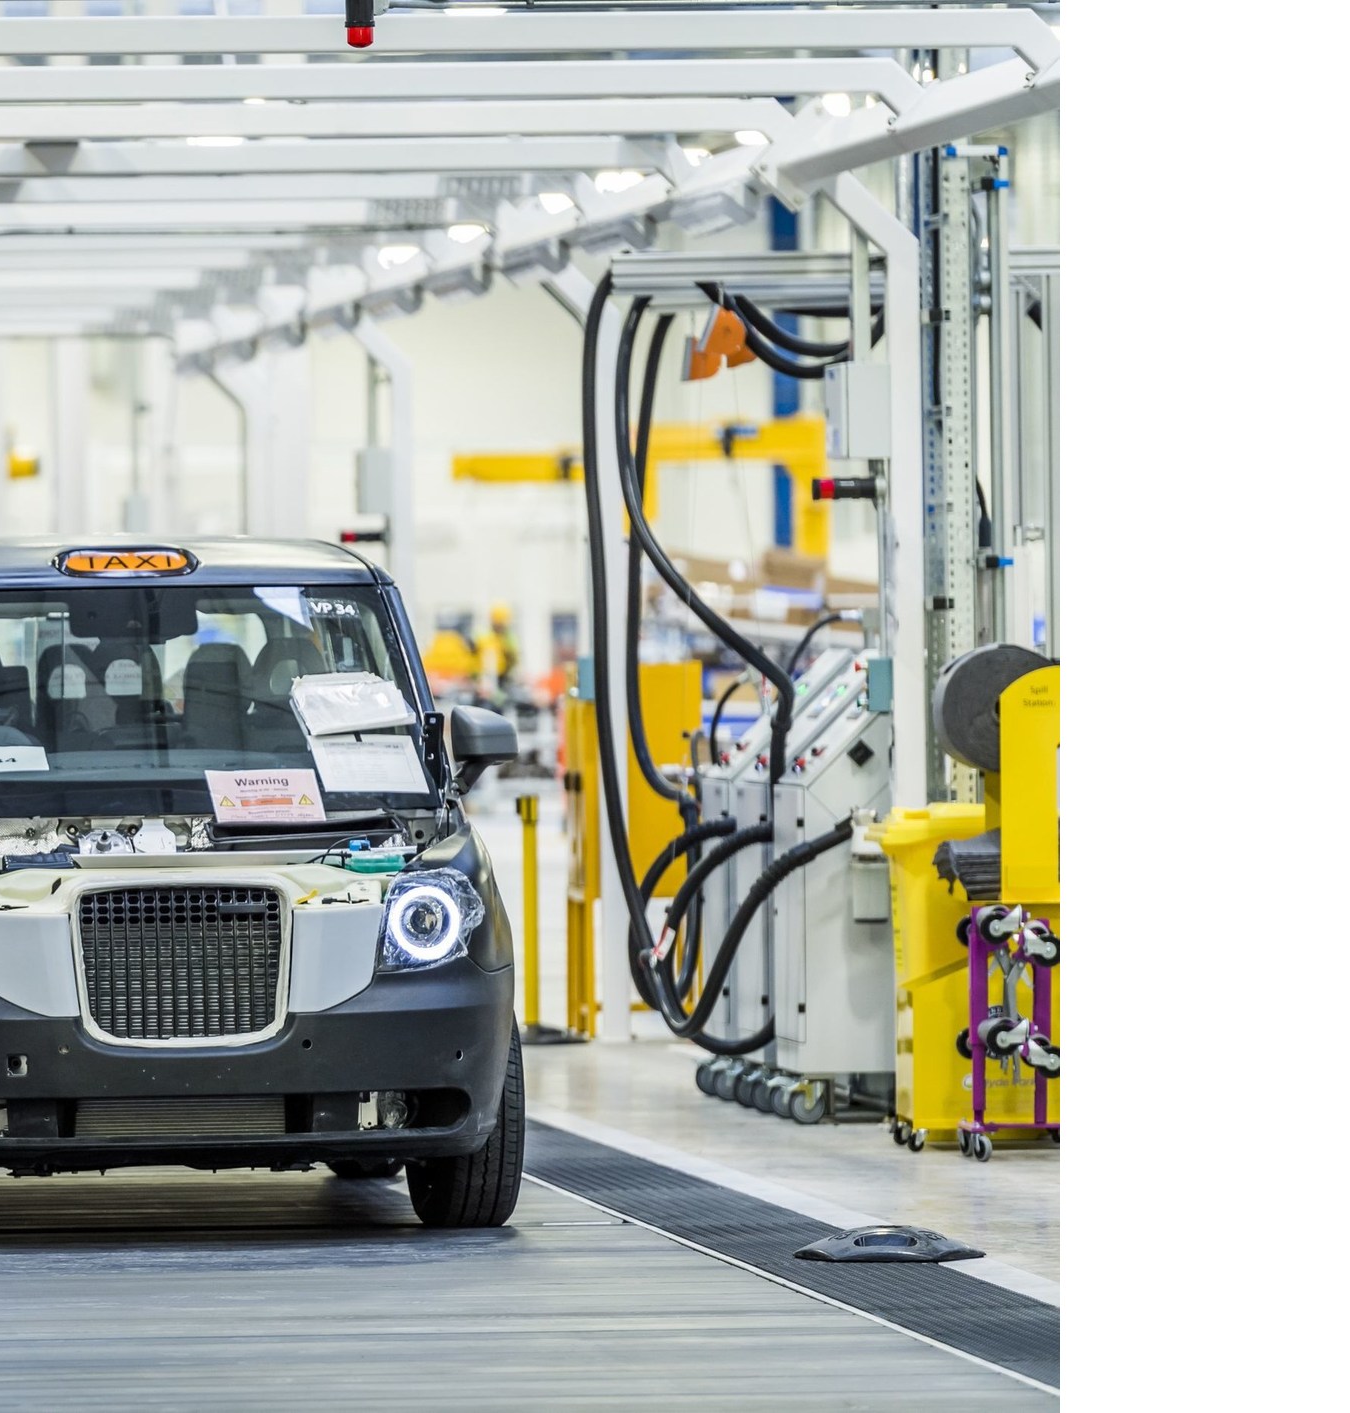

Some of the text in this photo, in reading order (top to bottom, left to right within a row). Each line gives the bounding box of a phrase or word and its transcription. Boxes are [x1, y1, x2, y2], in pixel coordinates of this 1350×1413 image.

[83, 554, 172, 569] TAXI
[310, 601, 356, 616] VP 34
[1030, 685, 1049, 696] Spill
[235, 776, 289, 787] Warning
